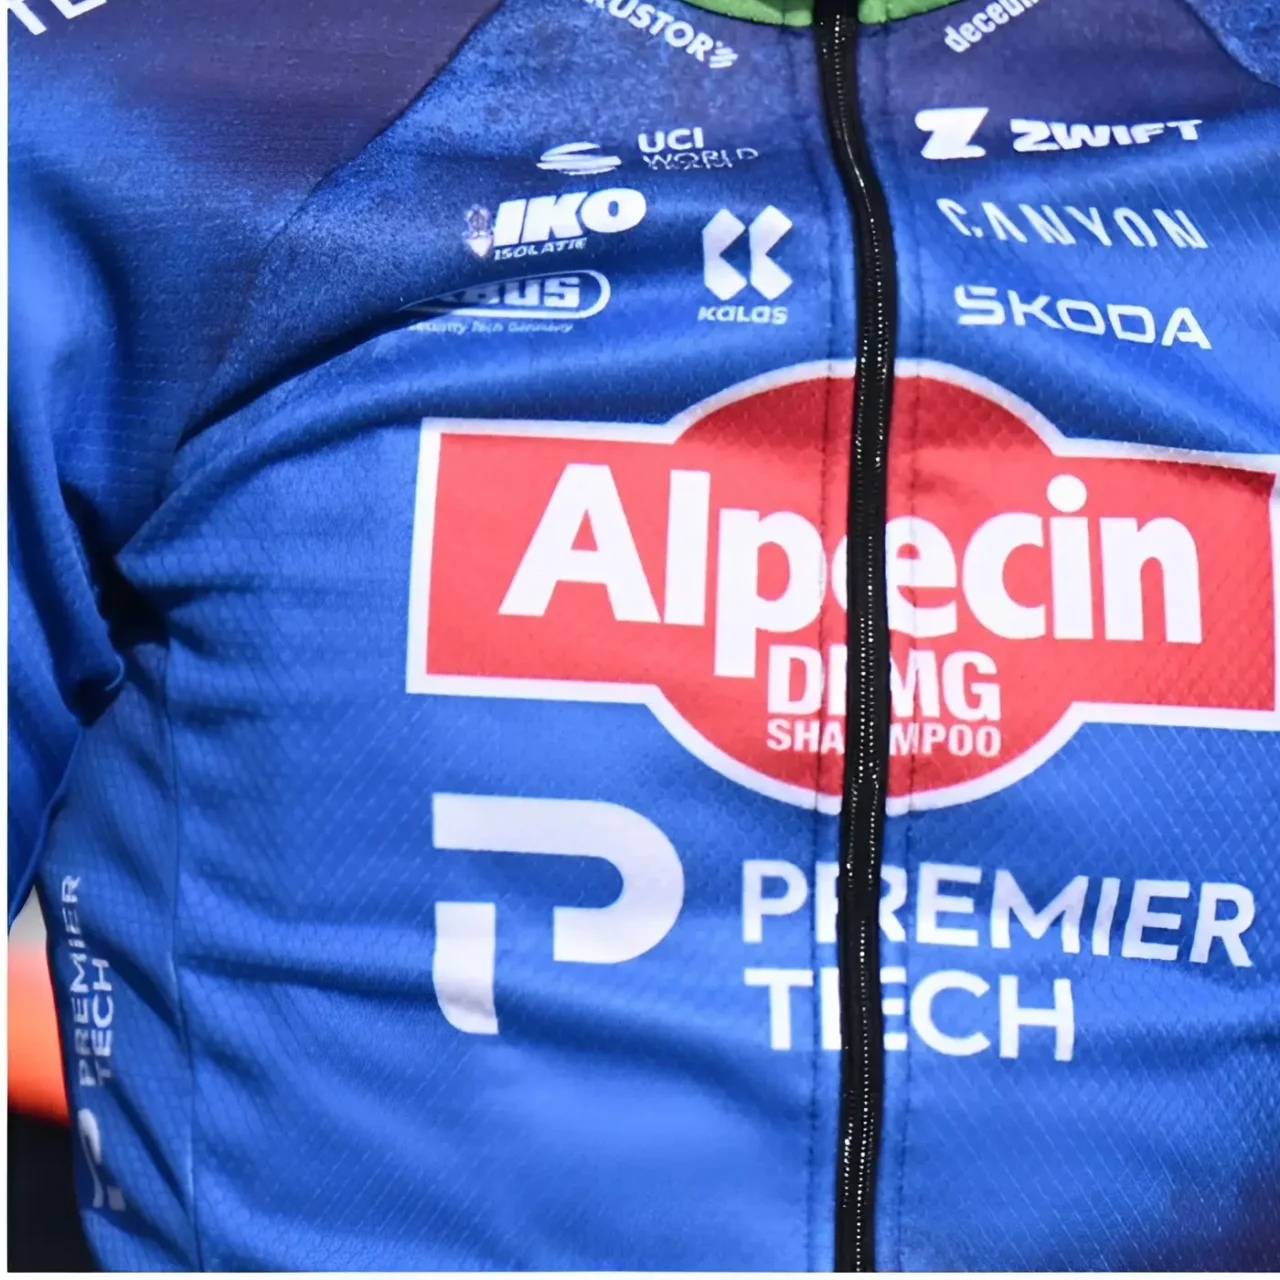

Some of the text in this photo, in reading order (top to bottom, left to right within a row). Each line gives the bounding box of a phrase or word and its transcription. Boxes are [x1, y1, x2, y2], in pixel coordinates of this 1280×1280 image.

[637, 126, 704, 153] UCI
[1010, 118, 1203, 153] ZWIFT
[493, 187, 647, 247] IKO
[936, 197, 1209, 249] CANYON
[441, 276, 581, 308] BUS
[498, 463, 1203, 679] Alpecin
[765, 643, 1001, 723] DMG
[765, 719, 1001, 757] SHAMPOO
[741, 858, 1257, 968] PREMIER
[743, 968, 1075, 1062] TECH
